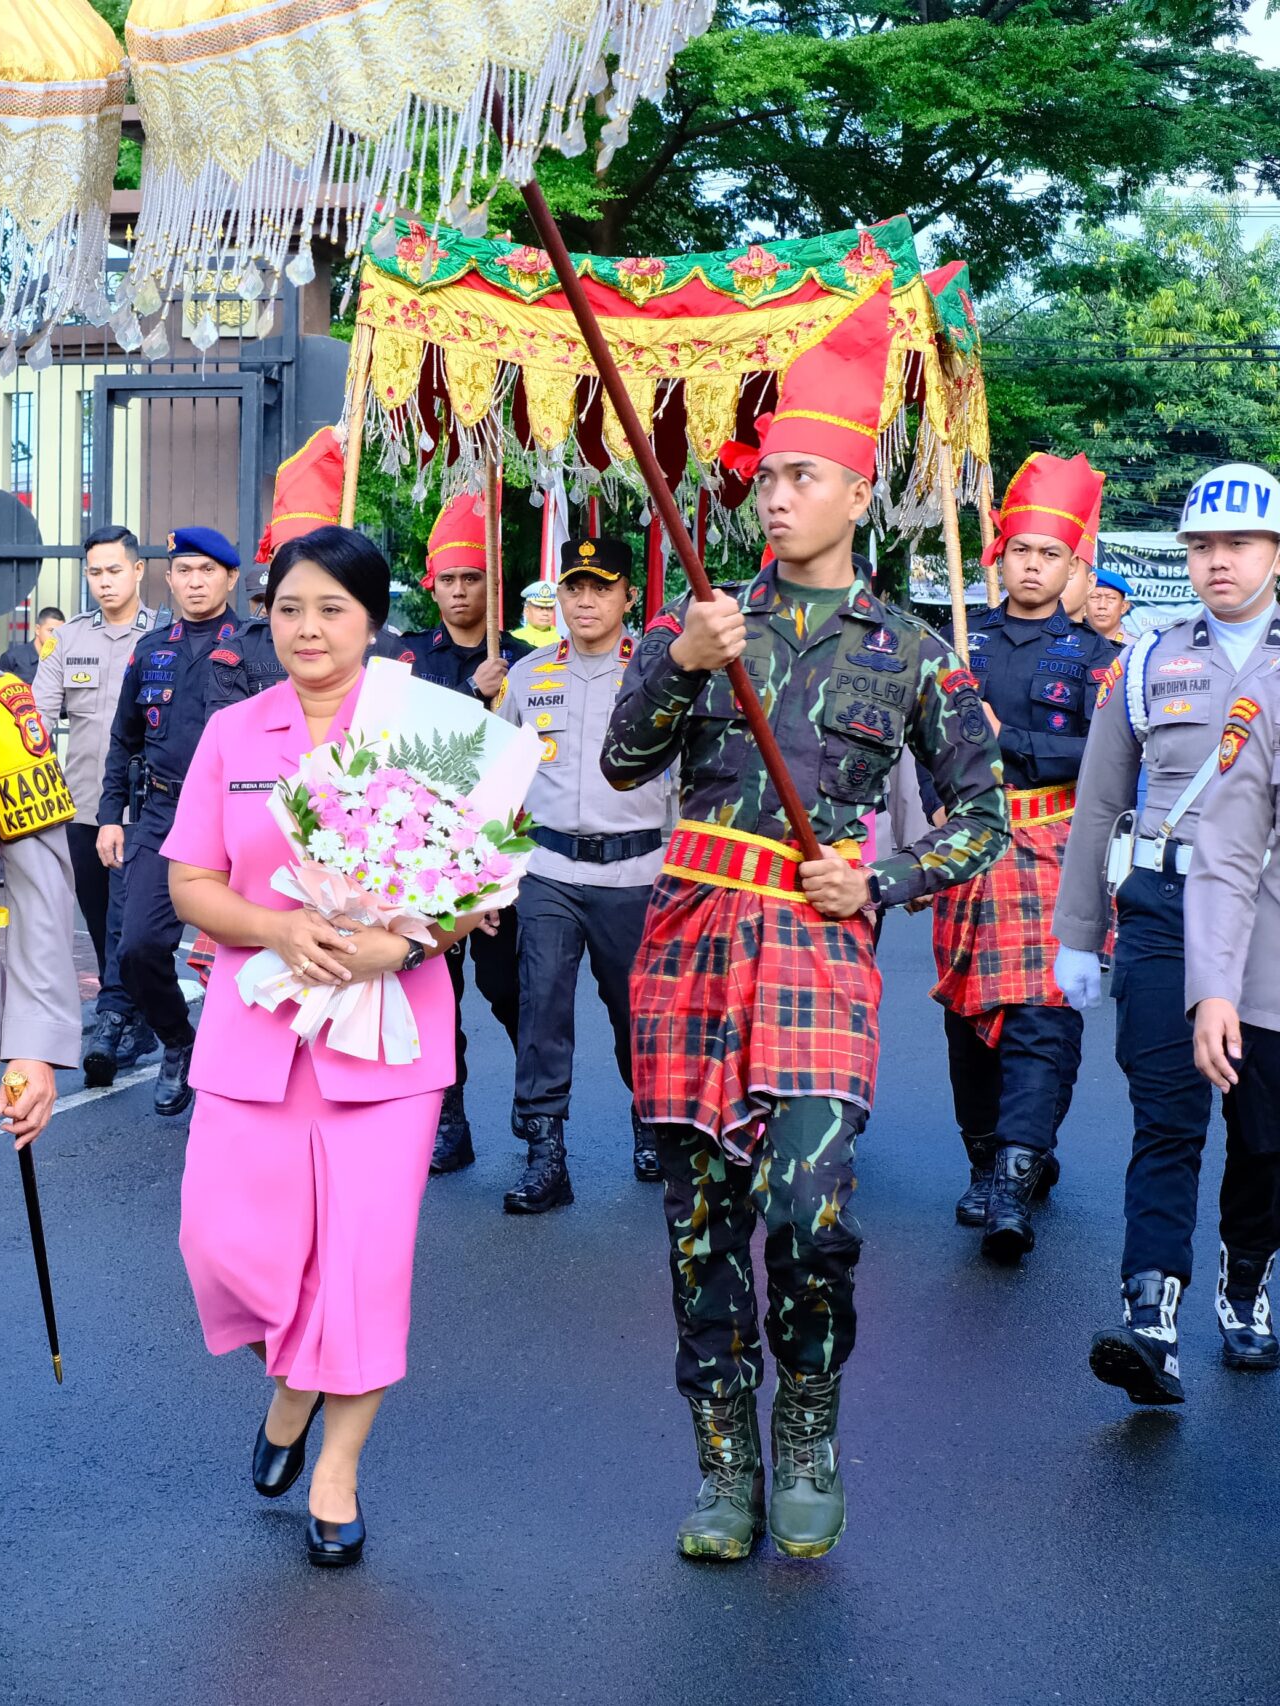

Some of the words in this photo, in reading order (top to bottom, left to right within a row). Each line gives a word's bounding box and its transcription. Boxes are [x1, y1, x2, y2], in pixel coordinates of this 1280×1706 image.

[1185, 480, 1271, 522] PROV
[1102, 562, 1154, 578] SEMUA
[1036, 660, 1083, 679] POLRI
[0, 685, 31, 700] POLDA
[836, 673, 907, 704] POLRI
[528, 694, 565, 707] NASRI
